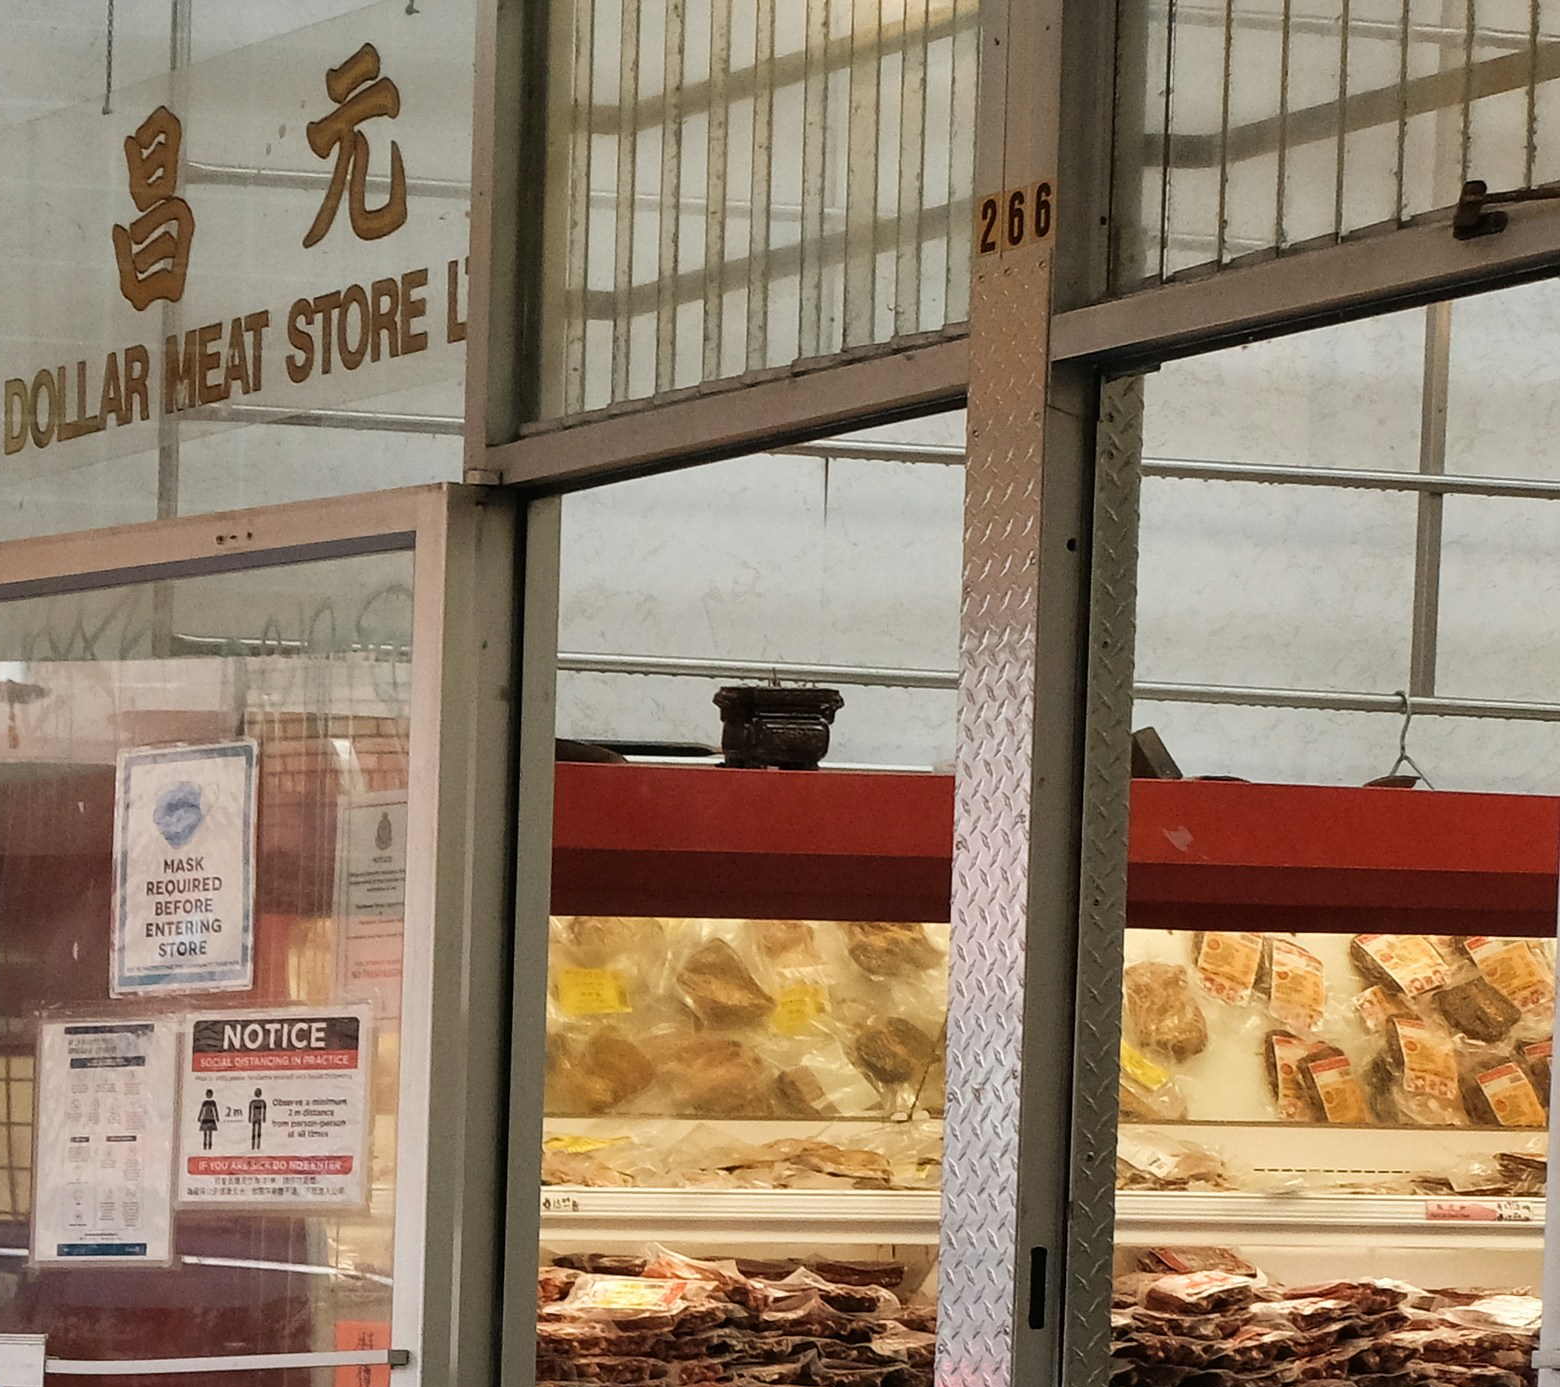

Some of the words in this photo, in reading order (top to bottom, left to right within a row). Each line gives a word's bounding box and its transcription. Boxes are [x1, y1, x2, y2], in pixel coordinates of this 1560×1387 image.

[980, 181, 1053, 255] 266
[4, 343, 150, 456] DOLLAR
[165, 309, 271, 414] MEAT
[286, 267, 429, 384] STORE
[164, 856, 204, 874] MASK
[146, 876, 223, 896] REQUIRED
[155, 898, 213, 916] BEFORE
[145, 918, 222, 938] ENTERING
[158, 941, 208, 958] STORE
[222, 1021, 328, 1050] NOTICE
[200, 1057, 233, 1067] SOCIAL
[235, 1055, 289, 1066] DISTANCING
[292, 1055, 301, 1065] IN
[303, 1054, 349, 1065] PRACTICE
[226, 1107, 232, 1117] 2
[233, 1109, 243, 1117] m
[198, 1161, 209, 1171] IF
[210, 1161, 229, 1171] YOU
[272, 1161, 287, 1170] DO
